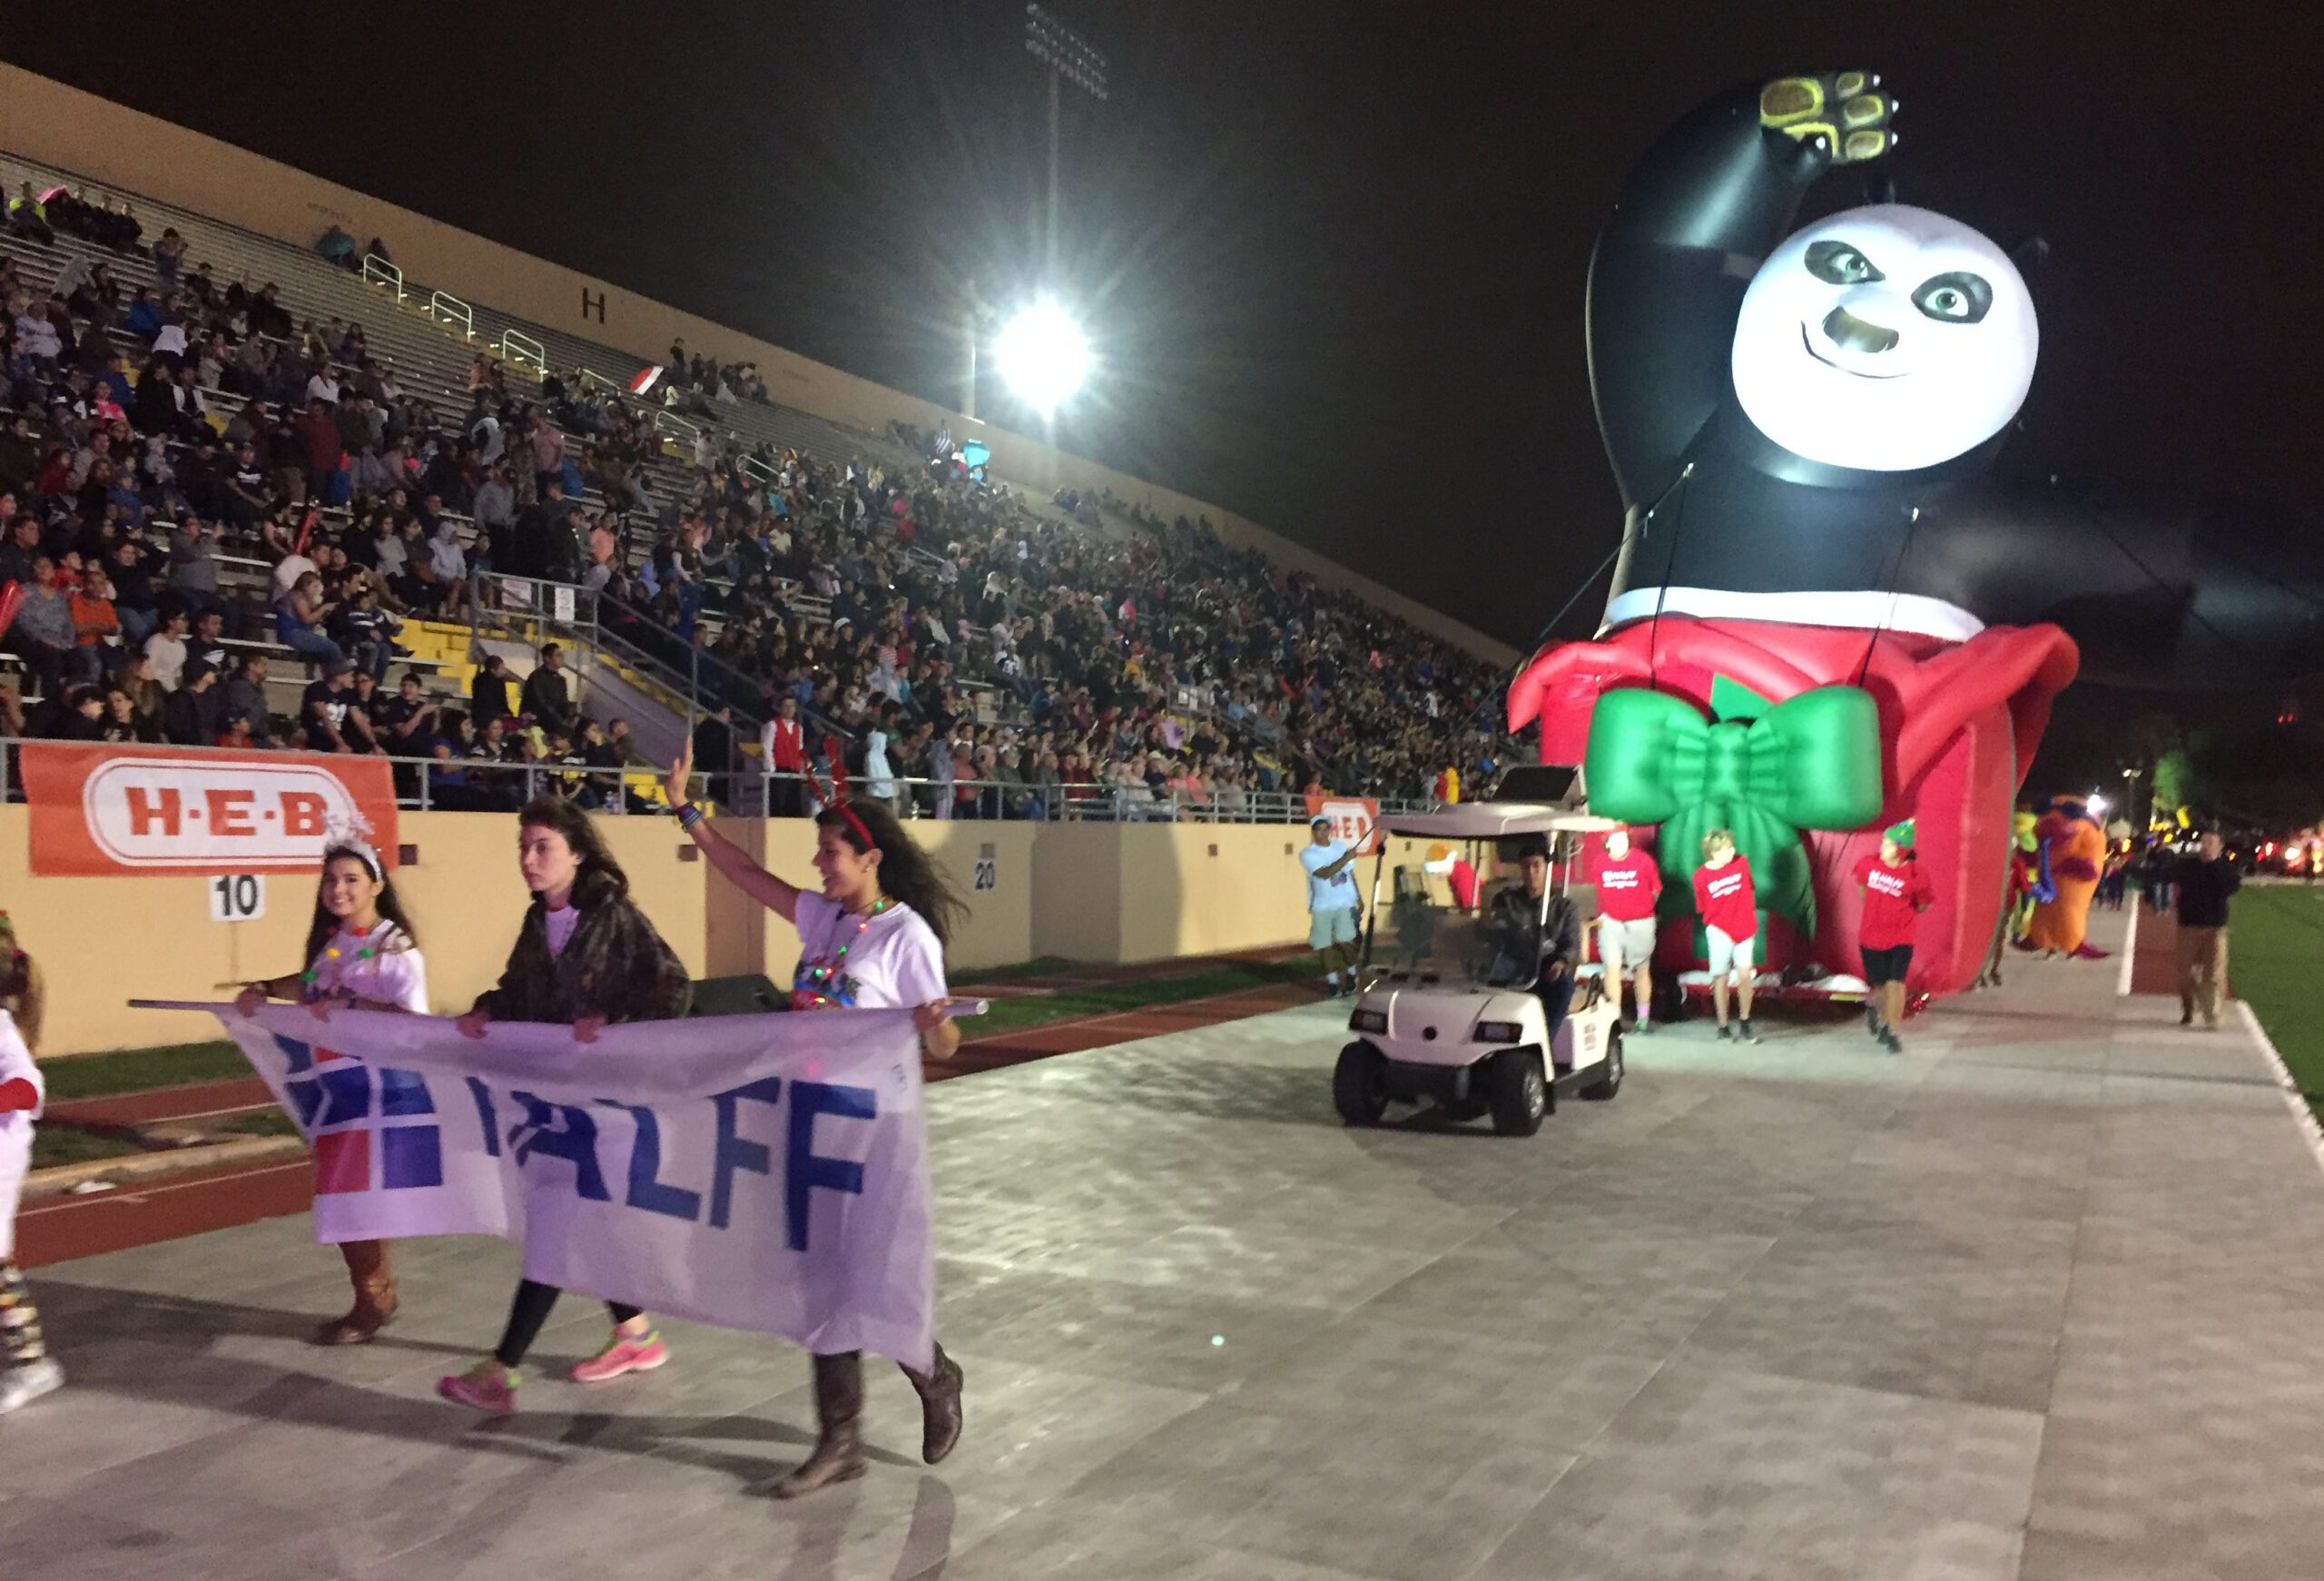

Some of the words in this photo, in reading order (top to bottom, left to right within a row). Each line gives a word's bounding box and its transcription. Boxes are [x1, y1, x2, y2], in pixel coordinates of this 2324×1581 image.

[582, 287, 605, 323] H
[975, 862, 995, 890] 20
[215, 874, 258, 916] 10
